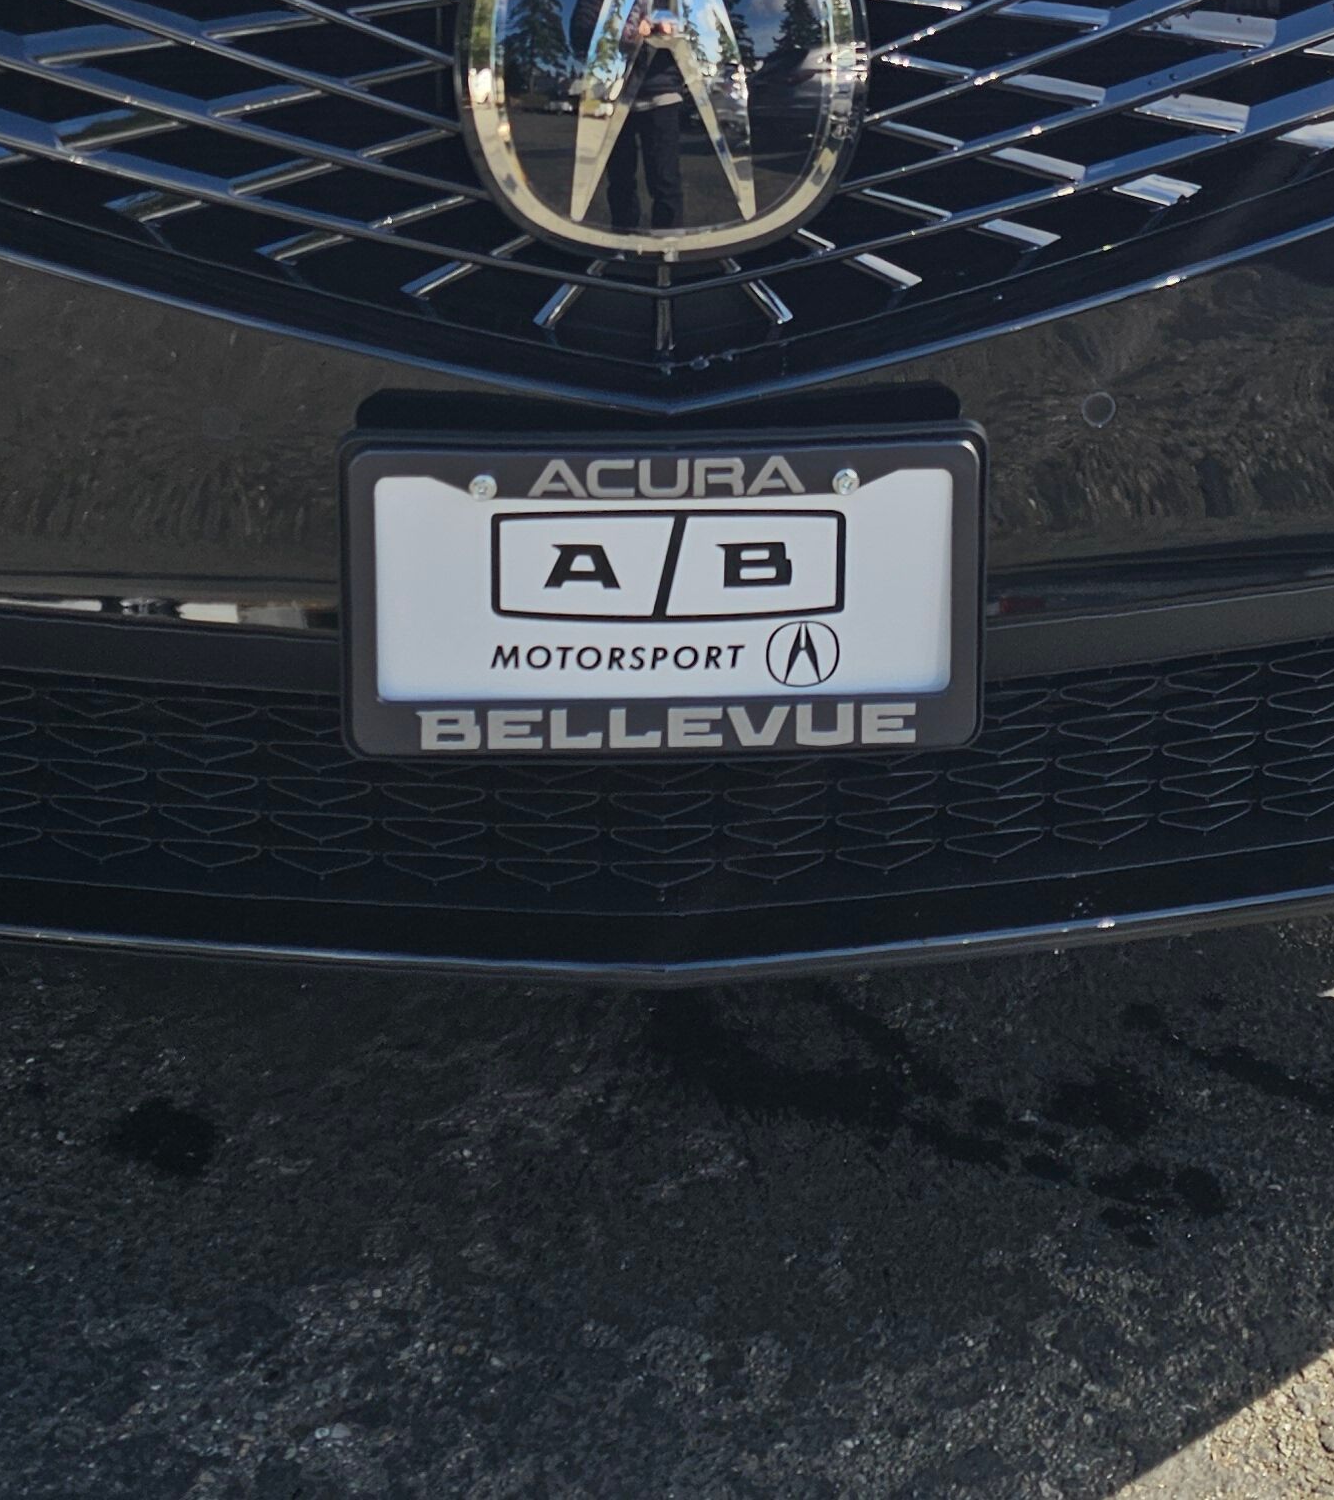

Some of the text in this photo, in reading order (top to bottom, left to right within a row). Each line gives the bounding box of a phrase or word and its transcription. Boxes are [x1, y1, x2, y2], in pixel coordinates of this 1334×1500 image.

[528, 455, 805, 498] ACURA
[490, 644, 746, 671] MOTORSPORT
[416, 702, 917, 751] BELLEVUE
